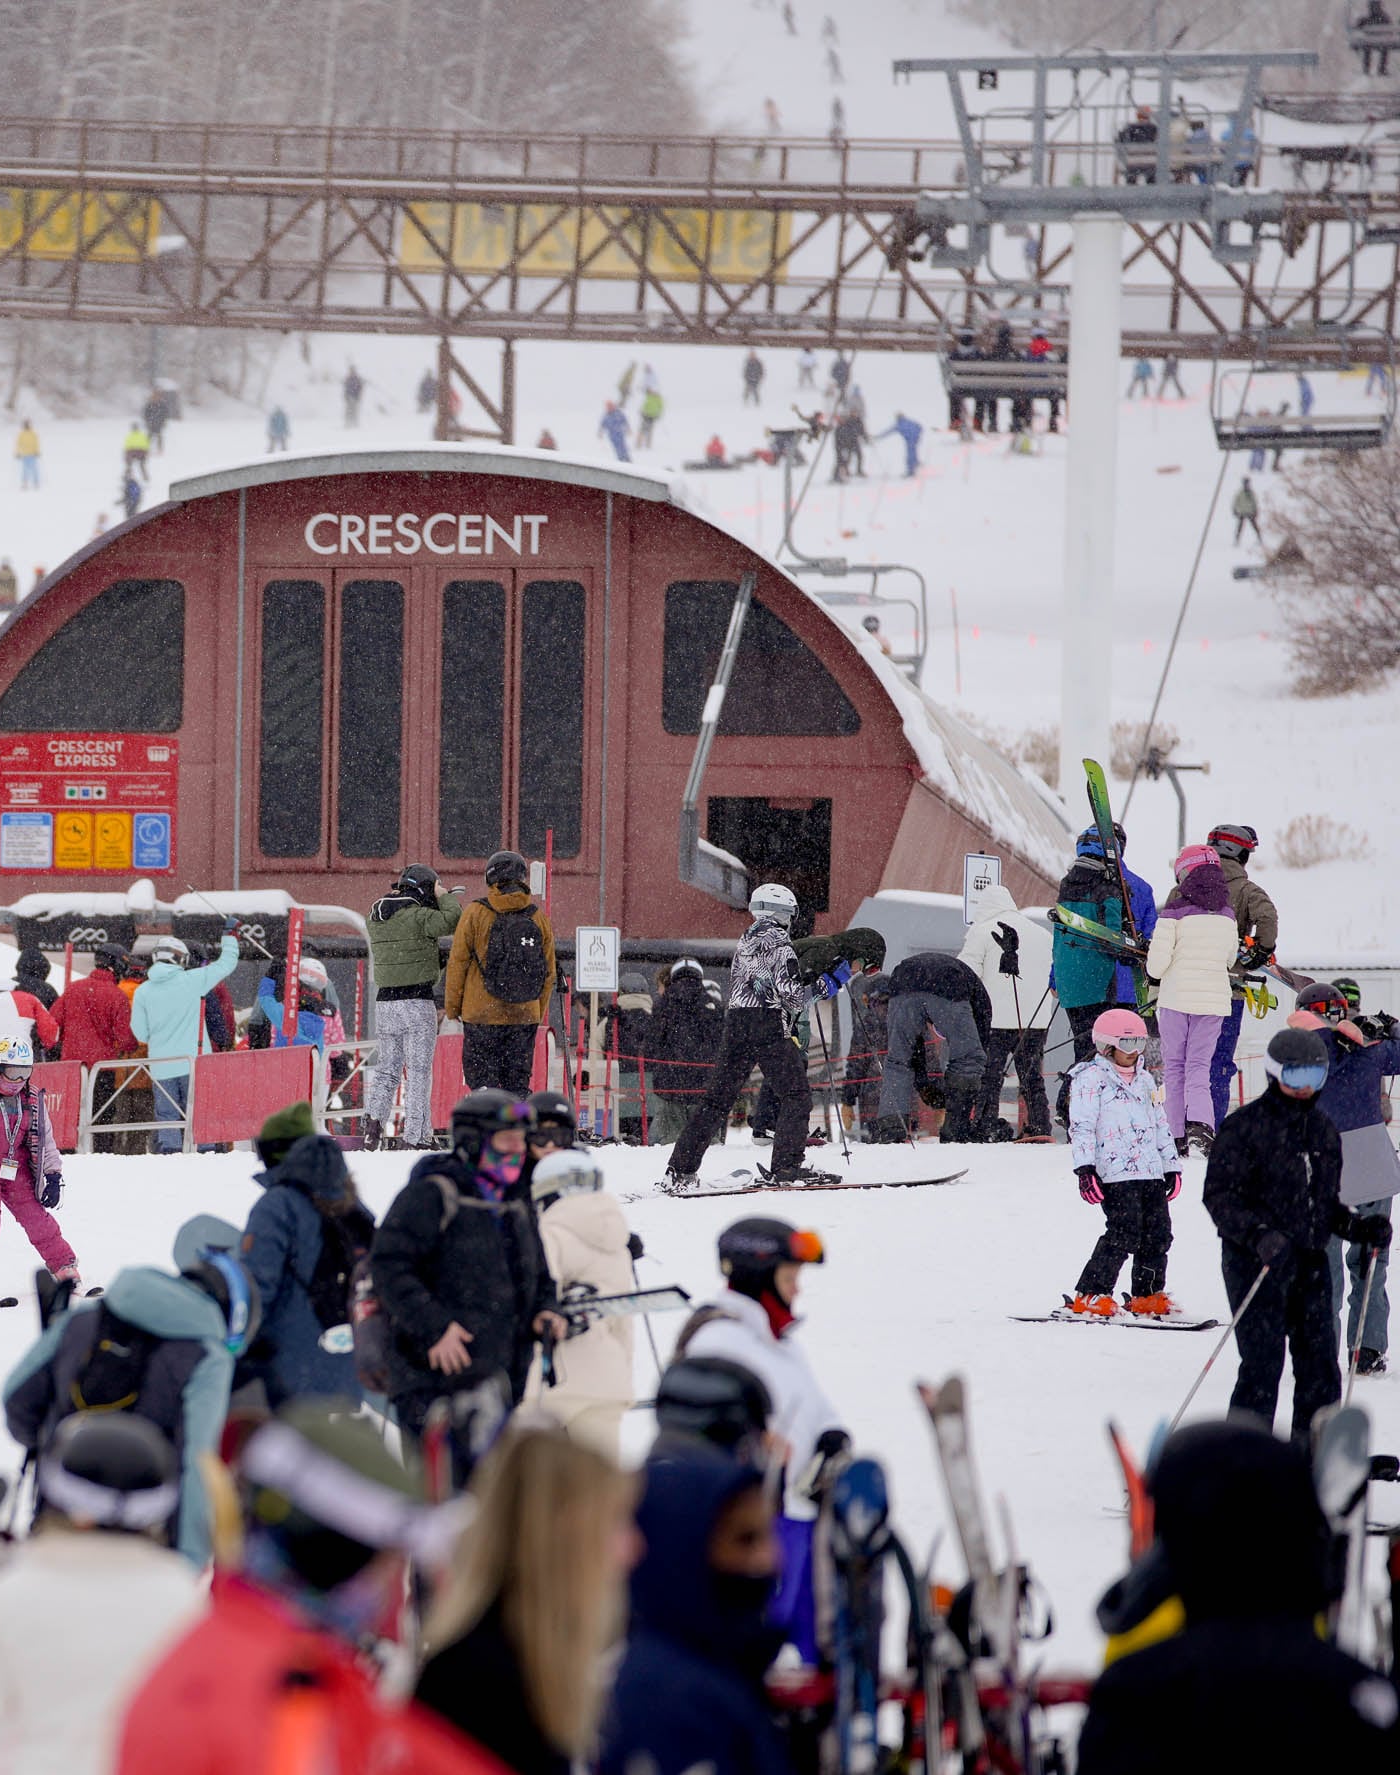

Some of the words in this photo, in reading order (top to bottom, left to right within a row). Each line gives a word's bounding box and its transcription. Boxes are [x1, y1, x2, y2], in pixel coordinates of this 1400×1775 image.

[304, 512, 549, 556] CRESCENT
[47, 740, 125, 753] CRESCENT
[54, 753, 117, 767] EXPRESS
